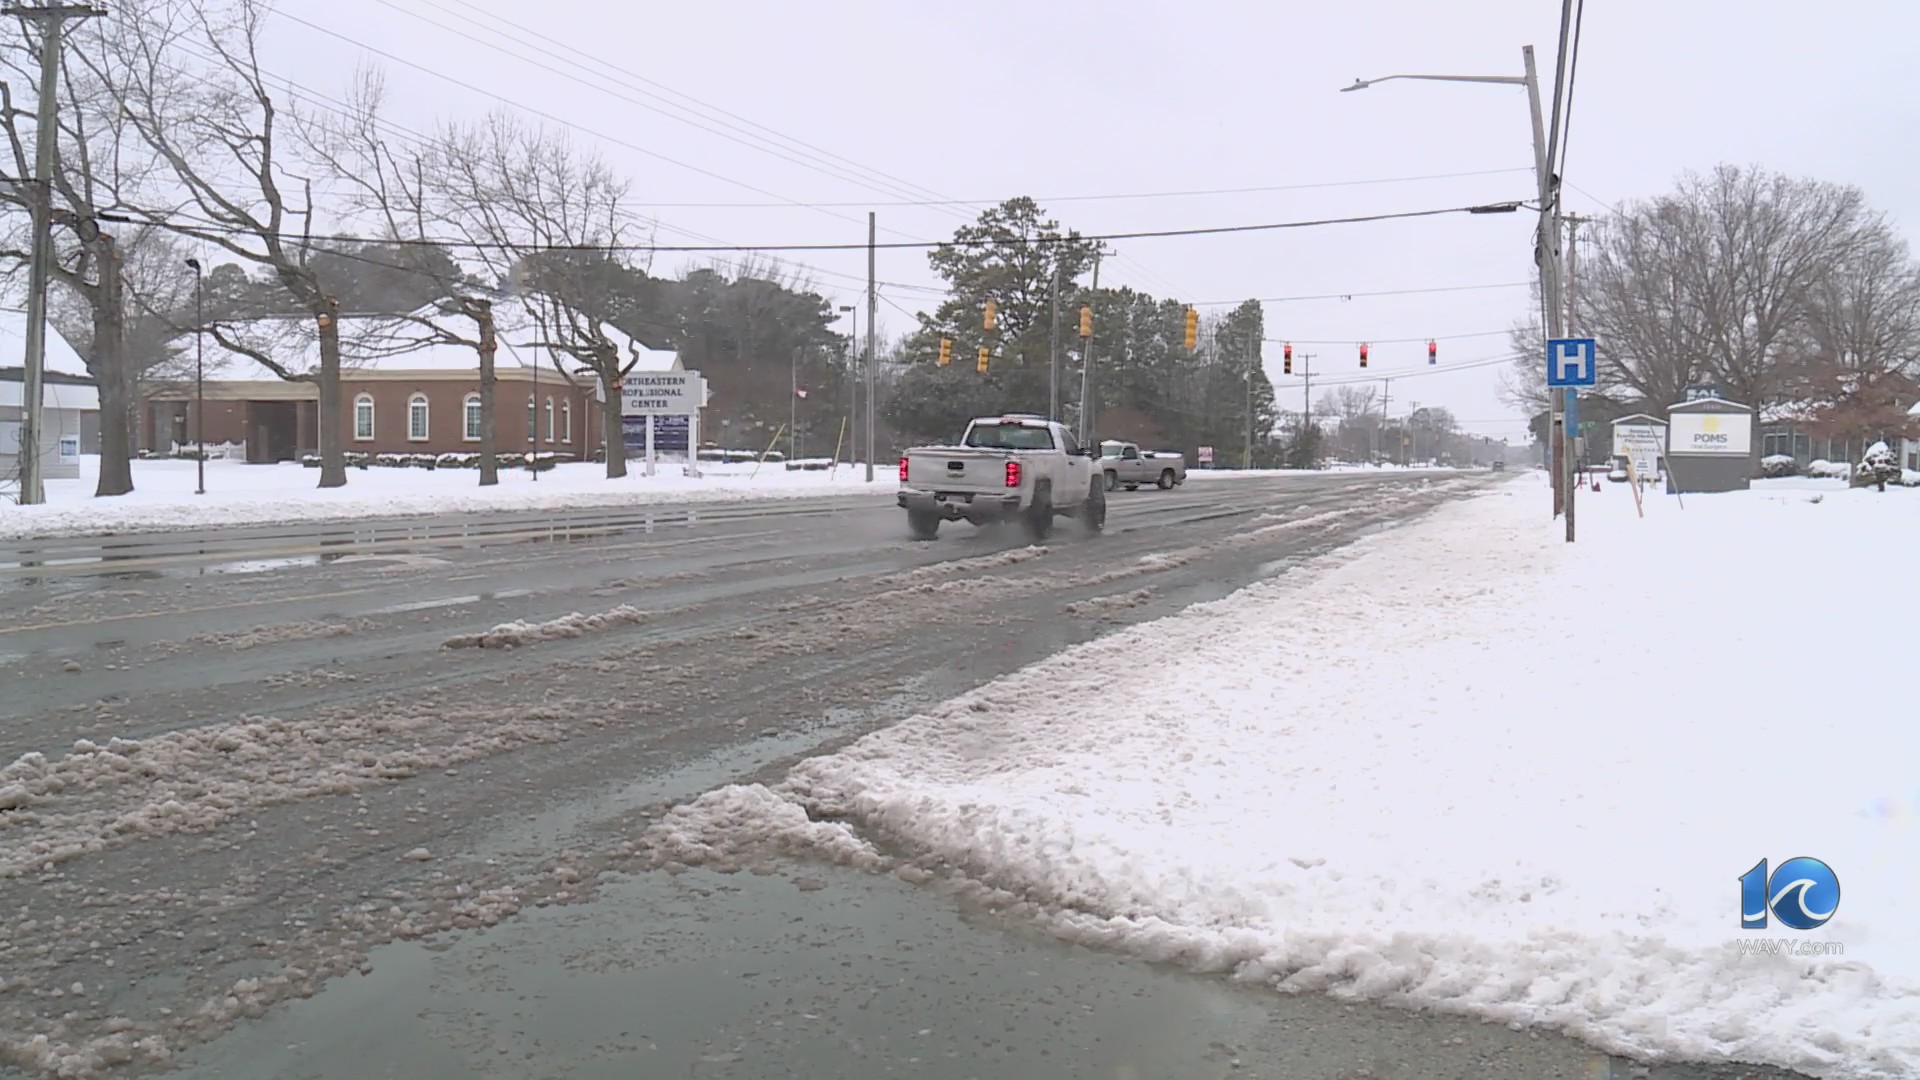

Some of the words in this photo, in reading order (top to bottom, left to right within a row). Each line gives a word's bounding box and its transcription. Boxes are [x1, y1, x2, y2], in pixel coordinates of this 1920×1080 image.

[1556, 344, 1587, 380] H
[624, 377, 686, 385] ORTHEASTERN
[631, 400, 668, 408] CENTER
[1694, 433, 1728, 443] POMS
